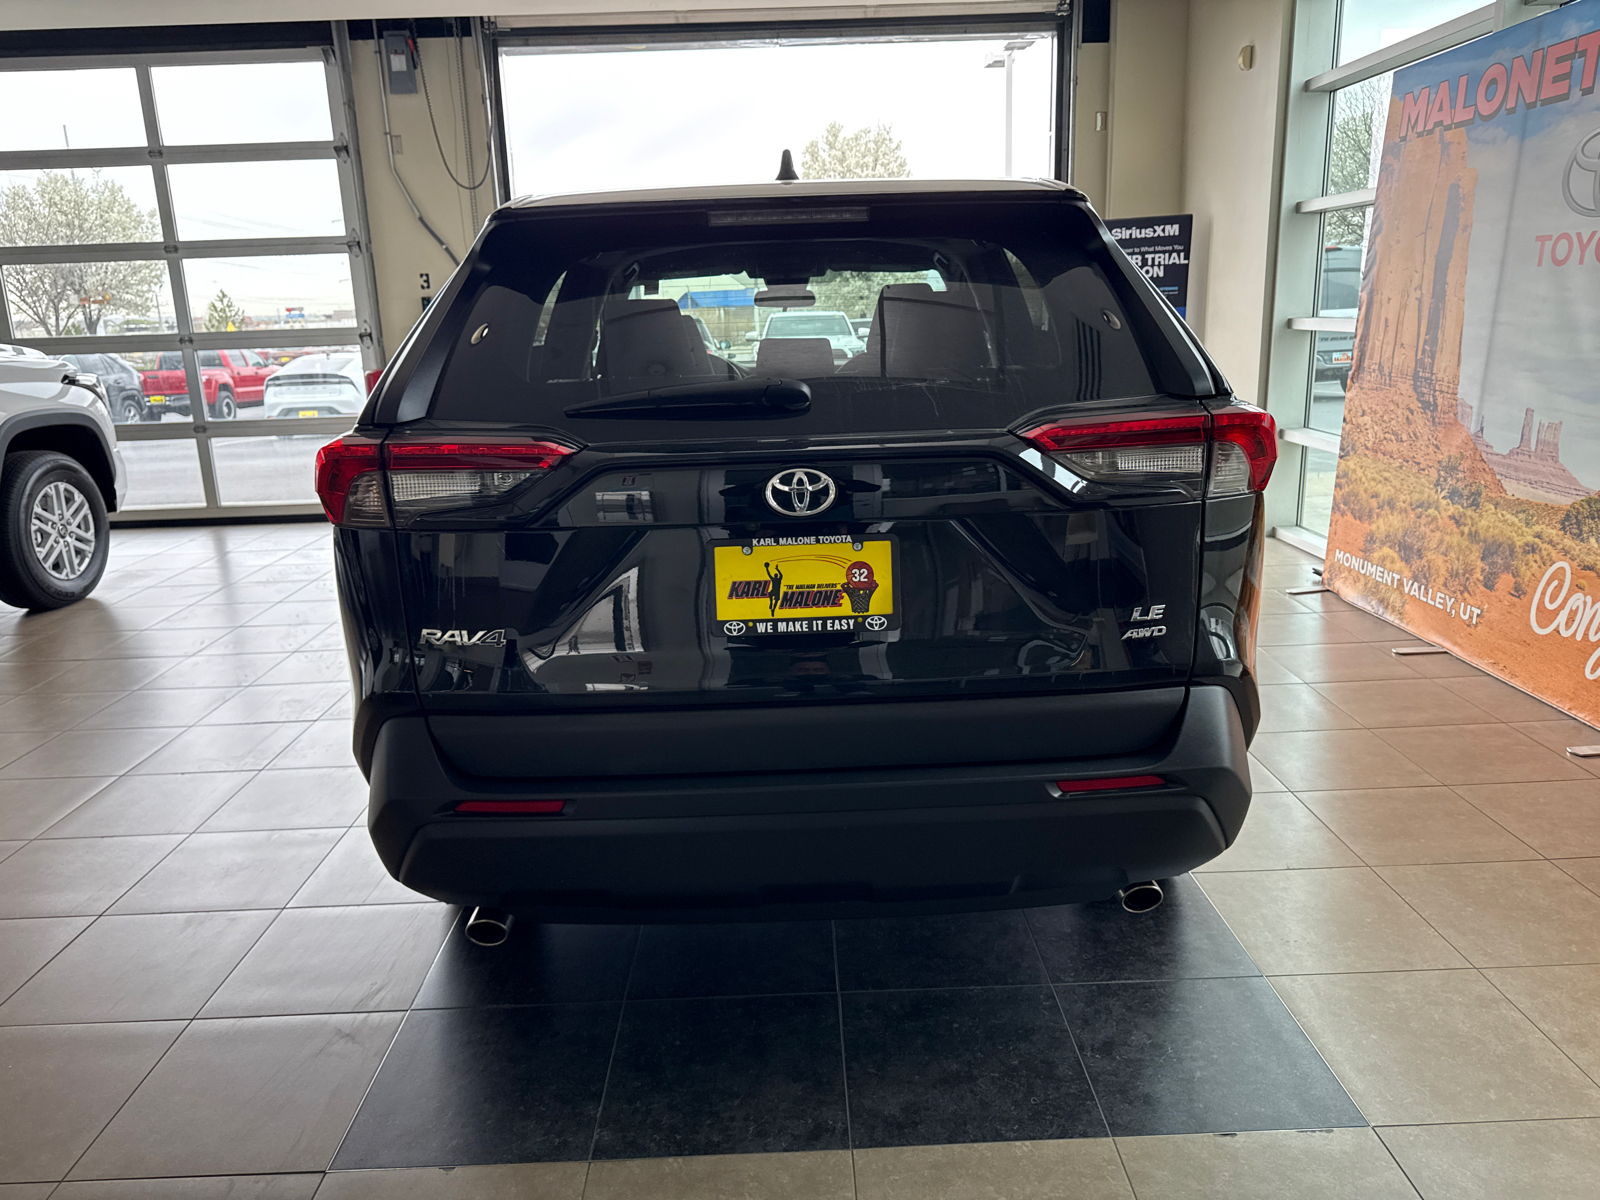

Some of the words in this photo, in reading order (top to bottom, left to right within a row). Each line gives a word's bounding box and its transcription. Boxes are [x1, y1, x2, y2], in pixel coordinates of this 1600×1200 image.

[1111, 223, 1180, 240] SiriusXM
[1535, 230, 1600, 268] TOY
[1145, 252, 1189, 266] TRIAL
[1142, 265, 1164, 278] ON
[419, 273, 431, 290] 3
[752, 537, 777, 547] KARL
[779, 536, 816, 546] MALONE
[818, 534, 853, 545] TOYOTA
[851, 568, 868, 582] 32
[727, 580, 772, 599] KARL
[1334, 548, 1401, 589] MONUMENT
[1403, 578, 1456, 618] VALLEY,
[1459, 603, 1482, 625] UT
[779, 589, 844, 609] MALONE
[1130, 604, 1166, 622] LE
[756, 622, 774, 633] WE
[776, 620, 809, 632] MAKE
[813, 619, 823, 631] IT
[826, 618, 855, 630] EASY
[1120, 625, 1167, 640] AWD
[419, 628, 507, 648] RAV4
